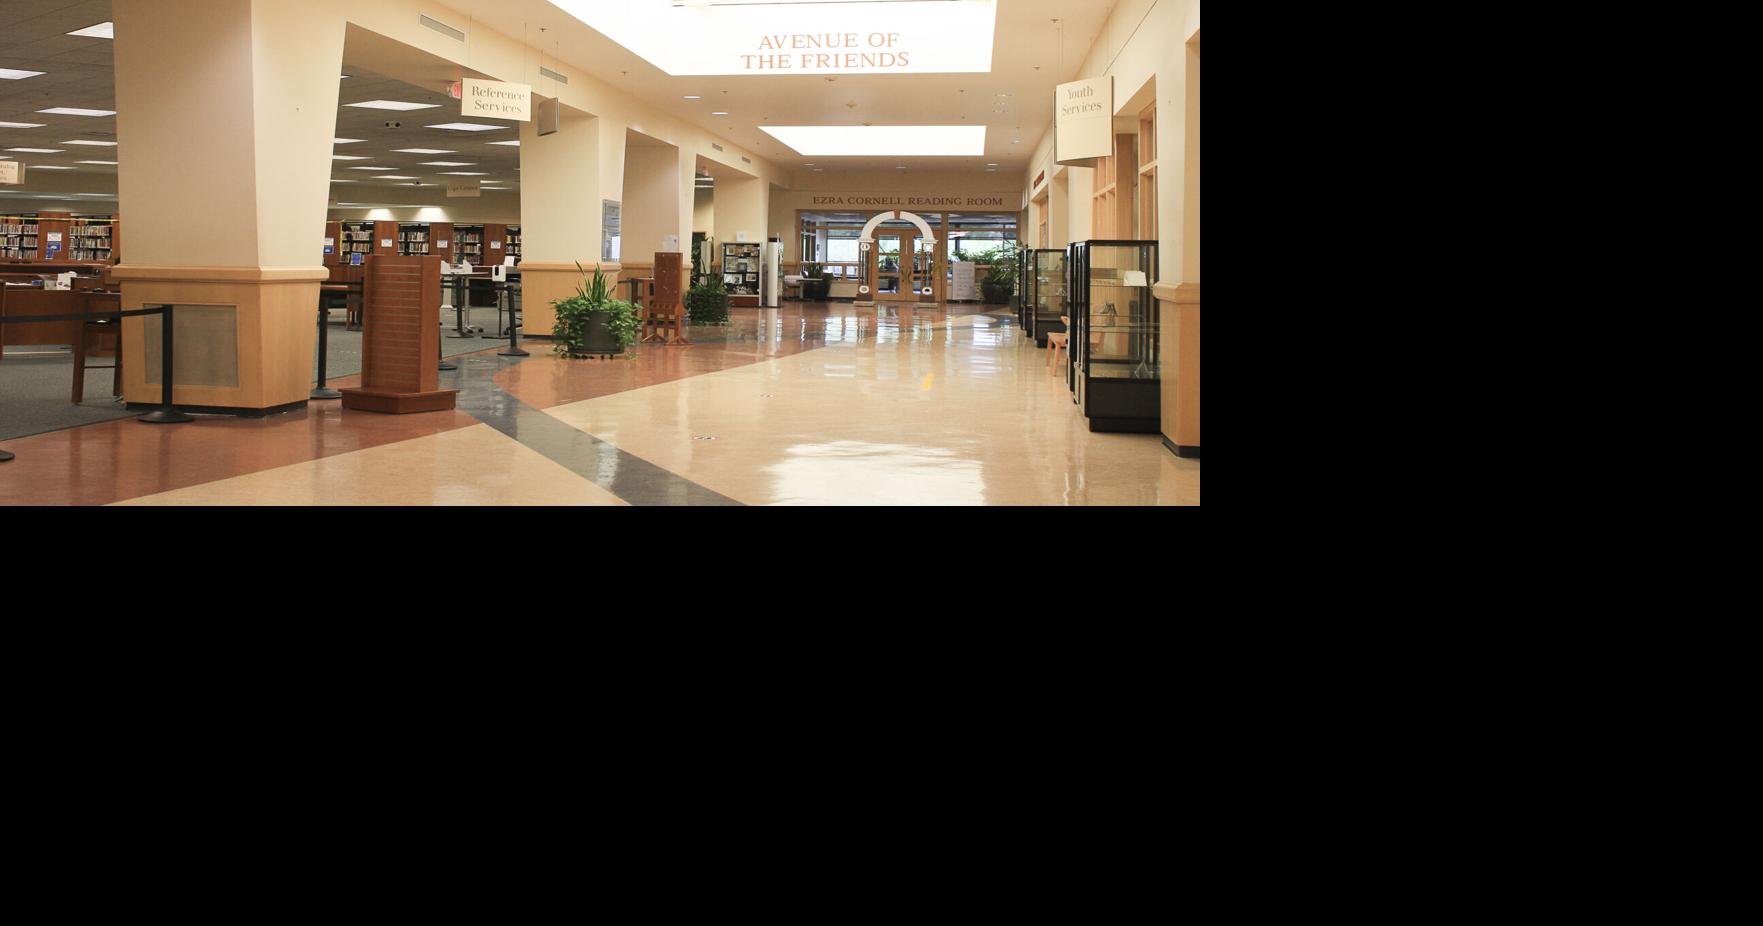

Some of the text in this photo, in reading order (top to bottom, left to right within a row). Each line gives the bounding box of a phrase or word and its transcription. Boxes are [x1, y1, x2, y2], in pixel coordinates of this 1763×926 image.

[758, 32, 899, 49] AVENUE OF
[740, 51, 909, 69] THE FRIENDS
[472, 86, 525, 100] Reference
[1067, 85, 1094, 100] Youth
[474, 100, 522, 113] Services
[1062, 102, 1103, 116] Services
[813, 196, 1003, 206] EZRA CORNELL READING ROOM
